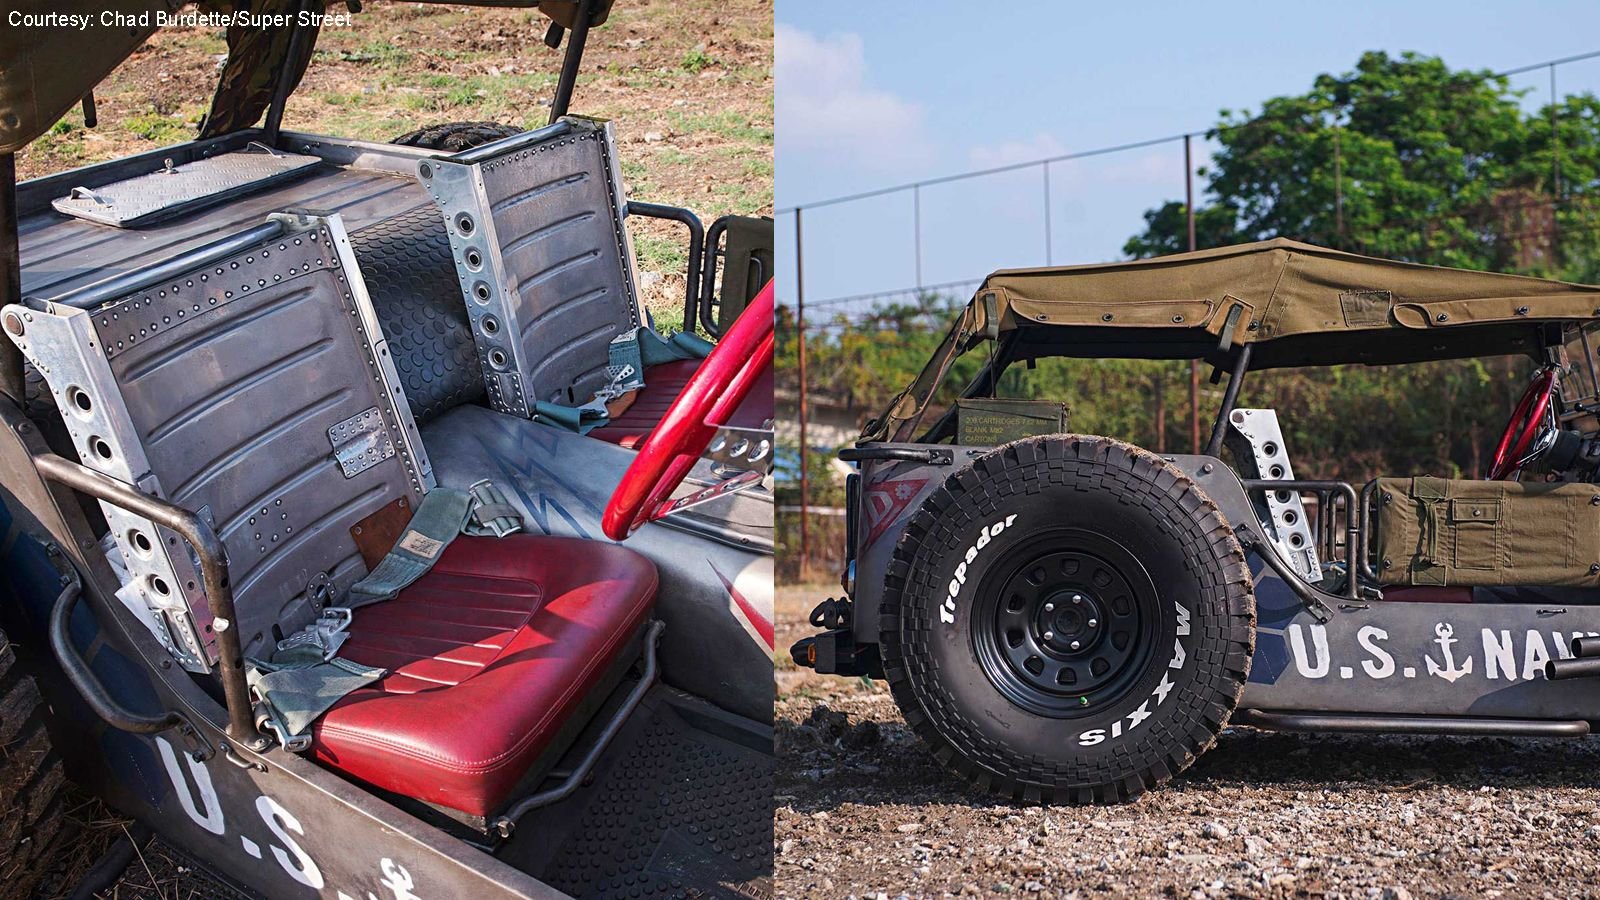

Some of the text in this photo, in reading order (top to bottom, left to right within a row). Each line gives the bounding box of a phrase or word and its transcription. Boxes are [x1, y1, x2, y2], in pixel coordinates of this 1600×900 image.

[965, 435, 998, 443] CARTONS
[939, 513, 1018, 624] Trepador
[1078, 600, 1191, 746] MAXXIS
[1289, 624, 1600, 682] U.S. NAV
